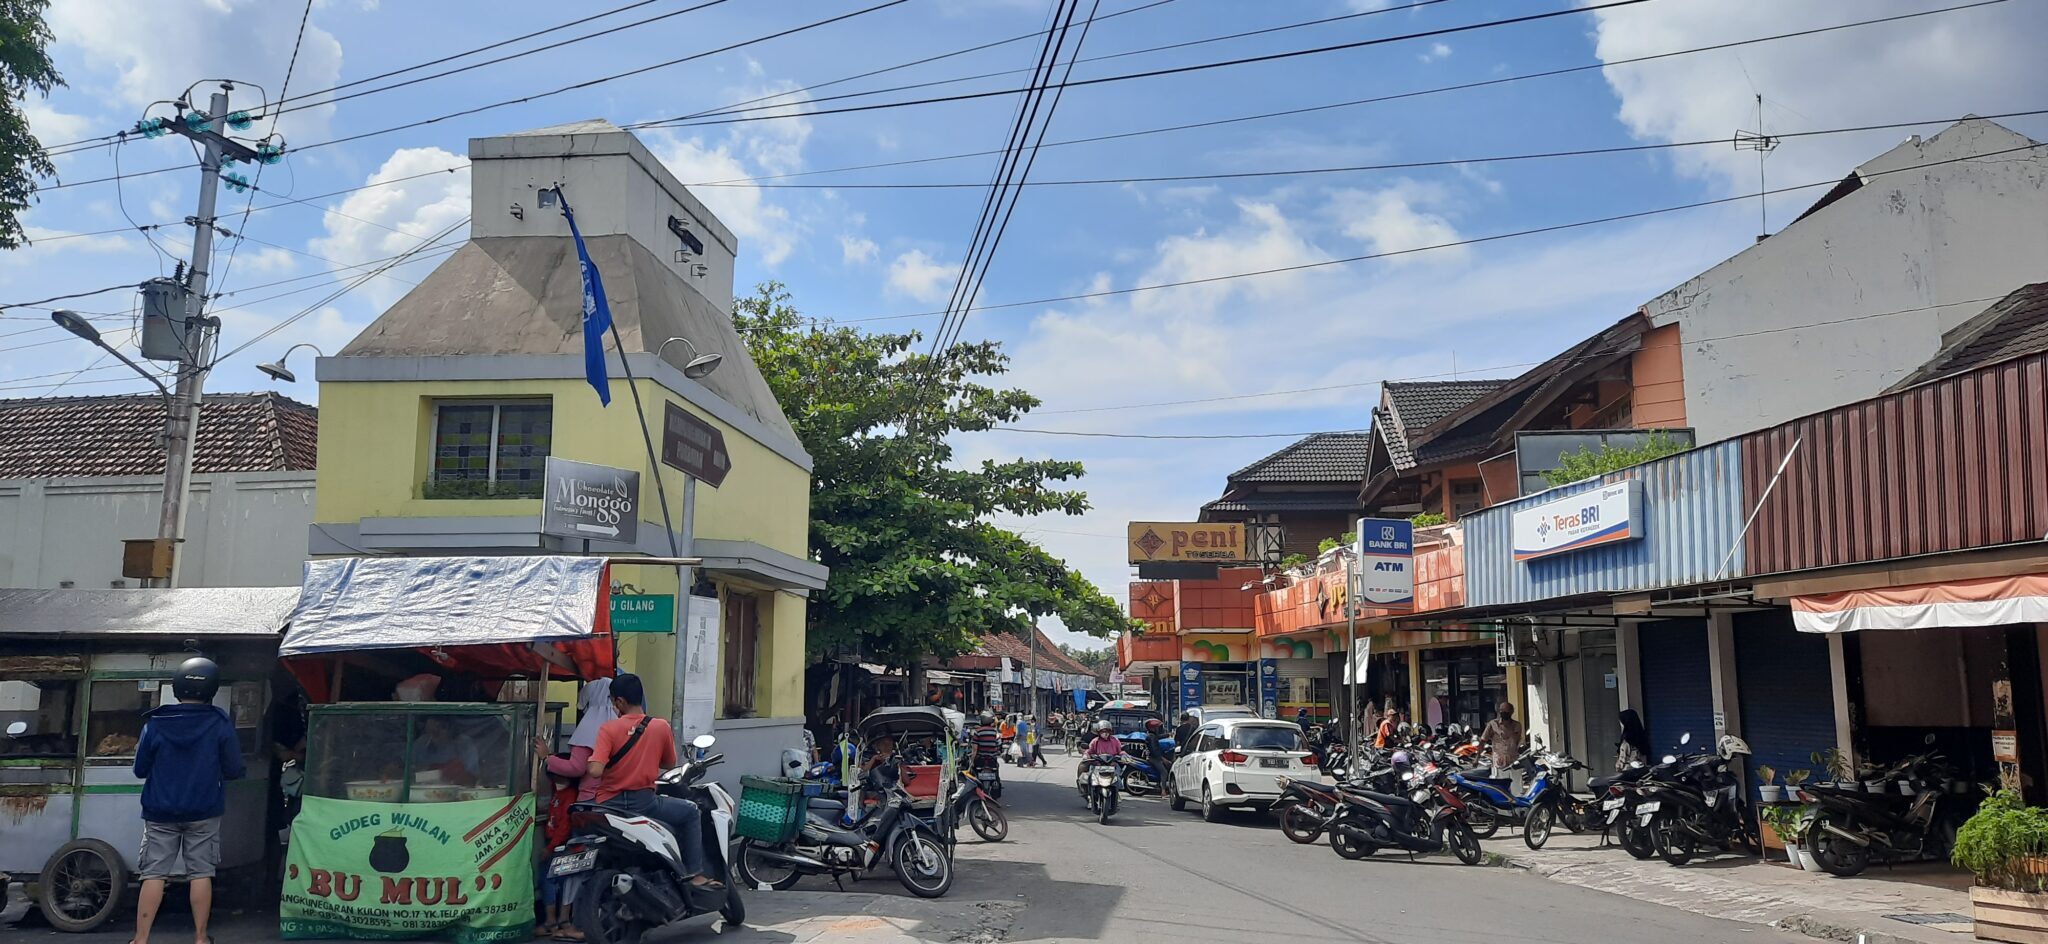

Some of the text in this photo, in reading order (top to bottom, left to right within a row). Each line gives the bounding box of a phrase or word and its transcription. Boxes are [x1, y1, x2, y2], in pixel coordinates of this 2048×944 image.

[577, 480, 614, 495] Chocolate
[555, 477, 632, 524] Monggo
[1553, 505, 1600, 531] Teras BRI
[1171, 525, 1237, 557] peni
[1369, 540, 1408, 550] BANK BRI
[1374, 561, 1404, 572] ATM
[620, 600, 655, 611] GILANG
[1144, 616, 1175, 633] eni
[330, 813, 451, 846] GUDEG WIJILAN
[474, 805, 523, 848] BUKA PAGI
[357, 906, 390, 918] KULON
[485, 902, 518, 915] 387387
